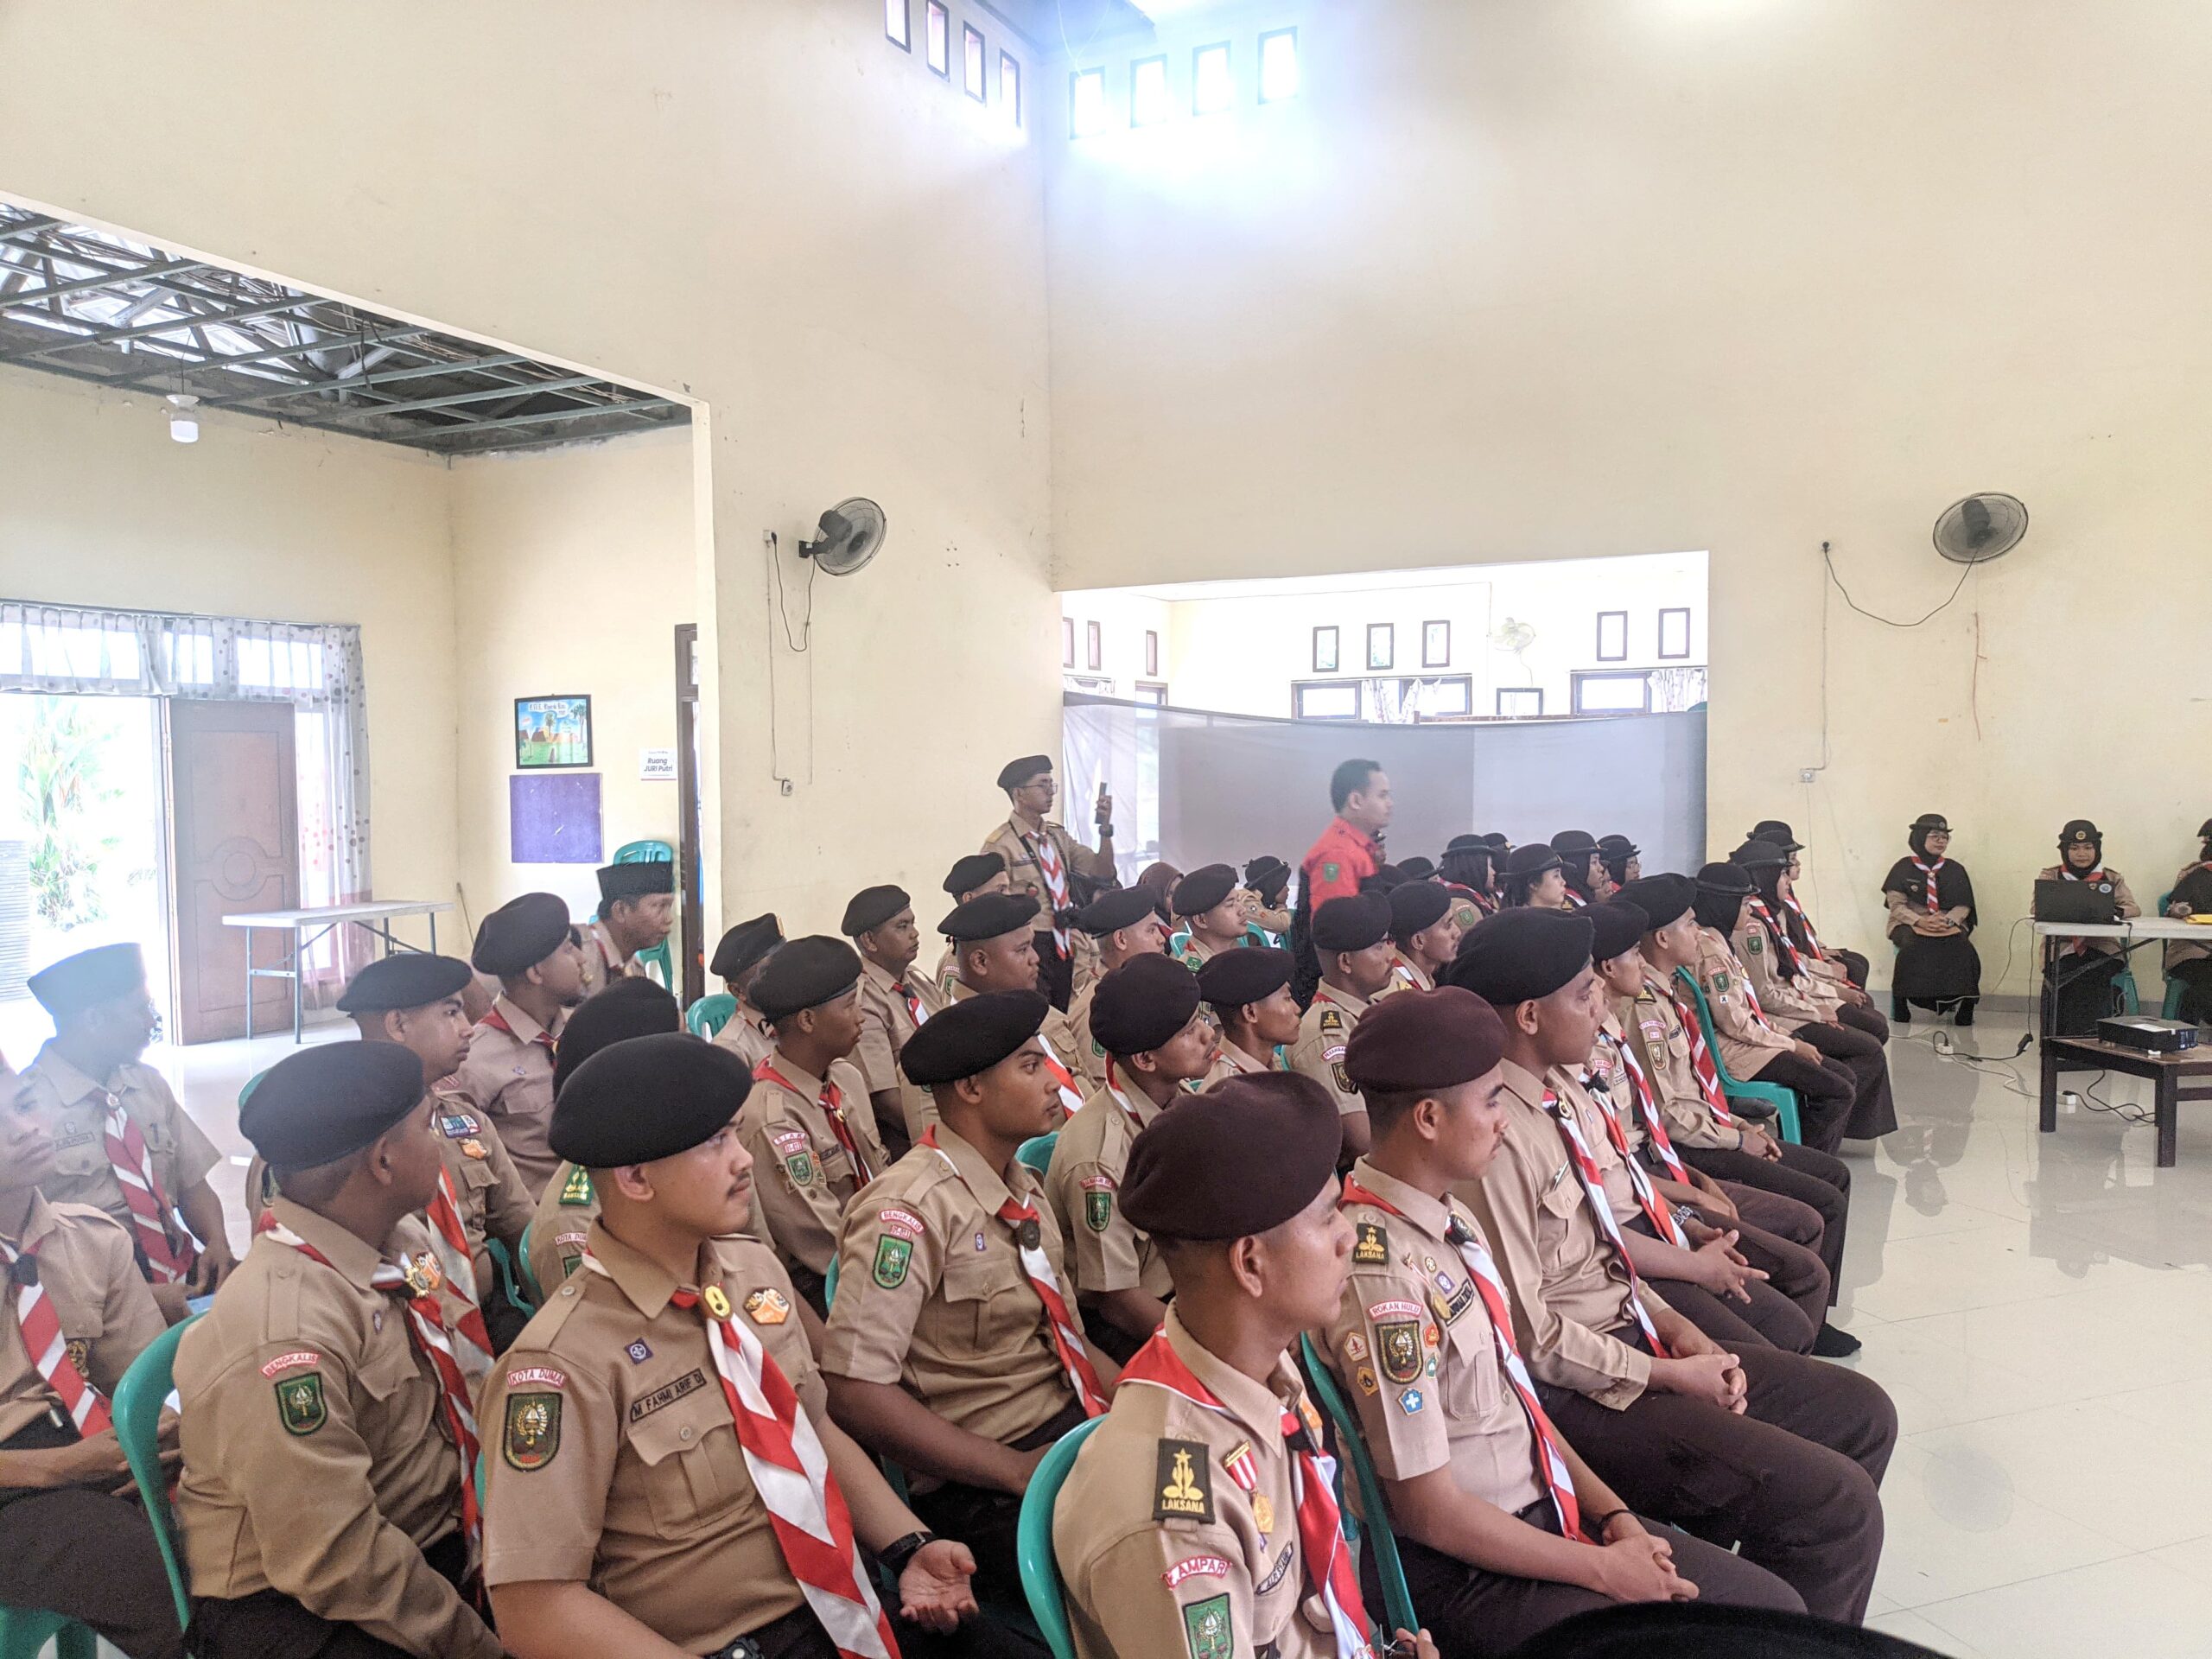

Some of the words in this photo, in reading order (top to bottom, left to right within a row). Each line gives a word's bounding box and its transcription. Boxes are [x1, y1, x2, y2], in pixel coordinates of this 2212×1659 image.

[883, 1211, 922, 1231] BENGKALIS
[1355, 1250, 1386, 1261] LAKSANA
[1371, 1302, 1400, 1316] ROKAN
[1402, 1302, 1420, 1314] HULU
[264, 1353, 318, 1375] BENGKALIS
[512, 1369, 534, 1384] KOTA
[633, 1404, 643, 1417] M
[646, 1388, 674, 1411] FAHMI
[675, 1377, 691, 1396] ARIF
[1161, 1499, 1205, 1515] LAKSANA
